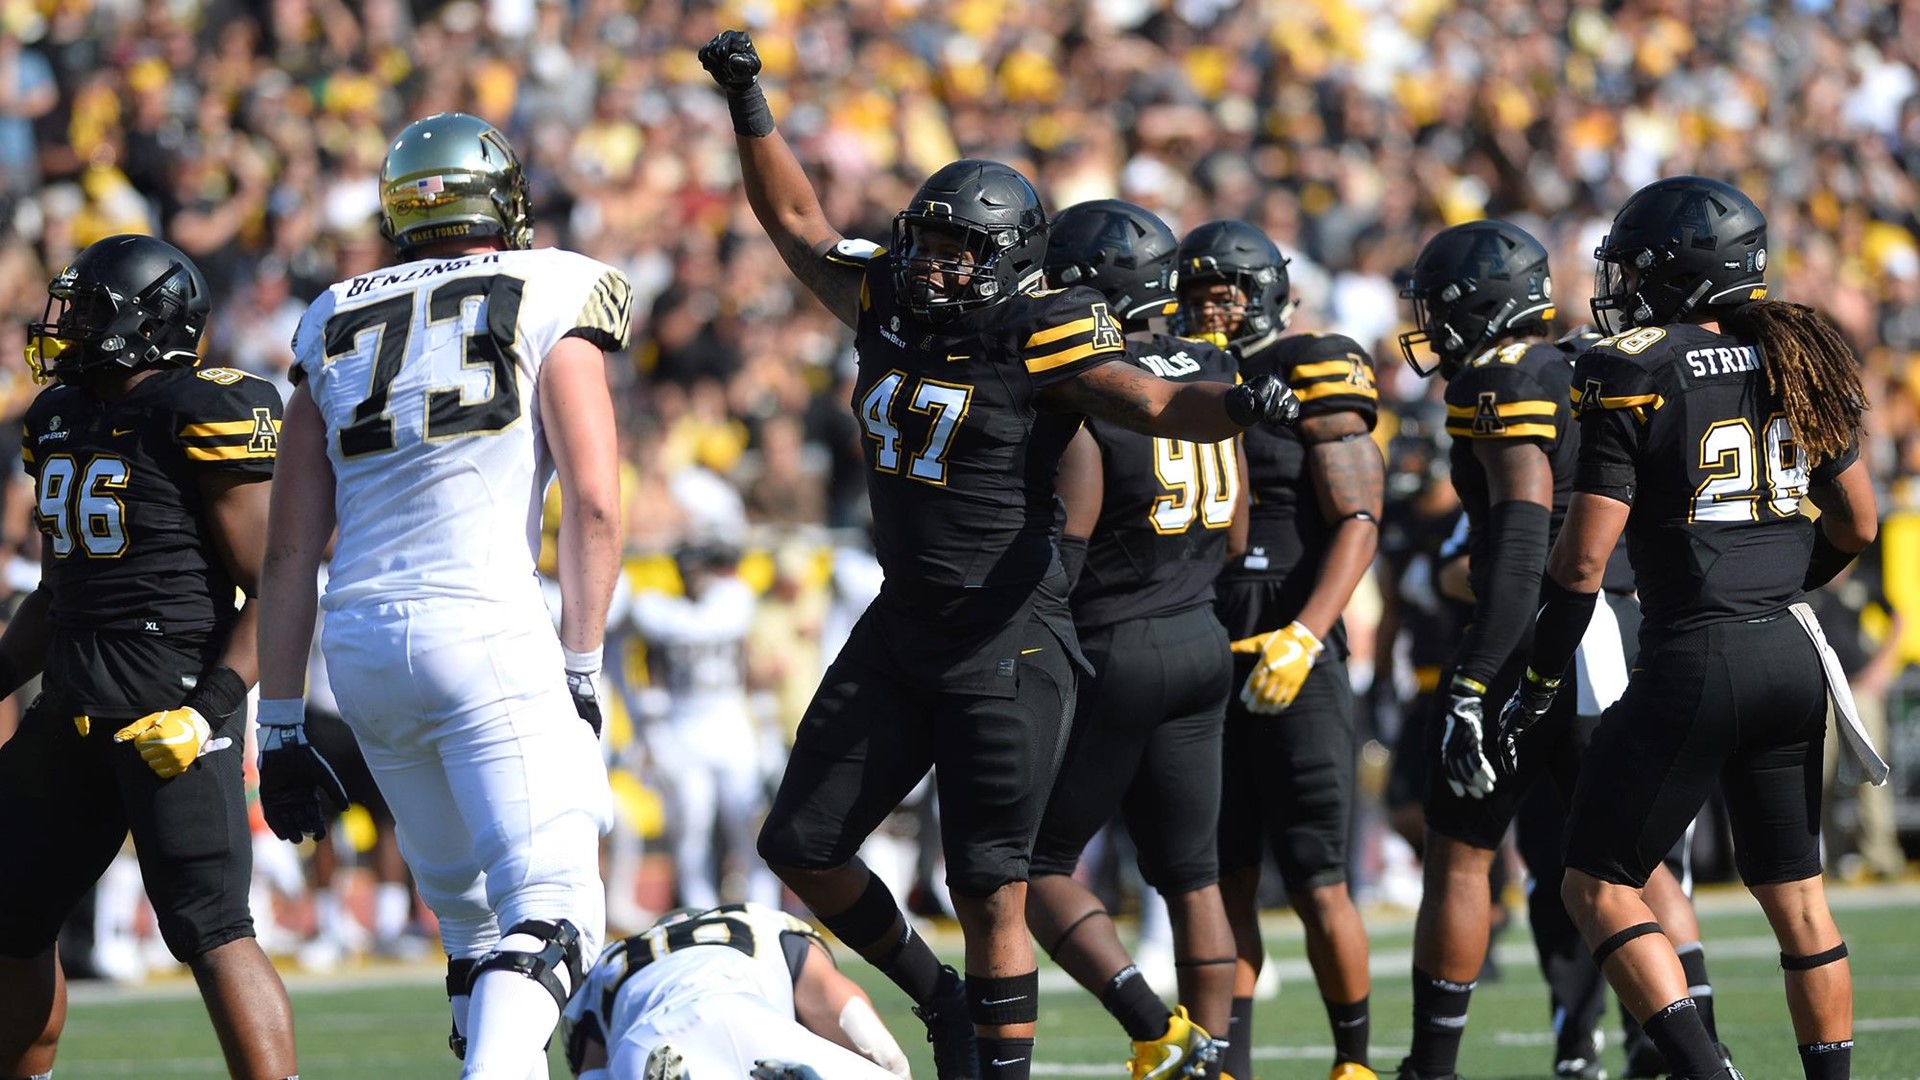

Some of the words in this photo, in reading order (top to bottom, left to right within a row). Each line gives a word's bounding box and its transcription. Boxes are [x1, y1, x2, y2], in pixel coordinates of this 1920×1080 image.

[411, 230, 433, 242] WAKE
[436, 224, 470, 237] FOREST
[1091, 303, 1121, 349] A
[324, 273, 528, 460] 73
[249, 408, 278, 452] A
[861, 368, 974, 486] 47
[1472, 392, 1506, 434] A
[1149, 436, 1240, 534] 90
[1688, 412, 1811, 523] 28
[37, 453, 131, 559] 96
[145, 621, 160, 631] XL
[1667, 998, 1691, 1013] NIKE
[1810, 1043, 1839, 1052] NIKE
